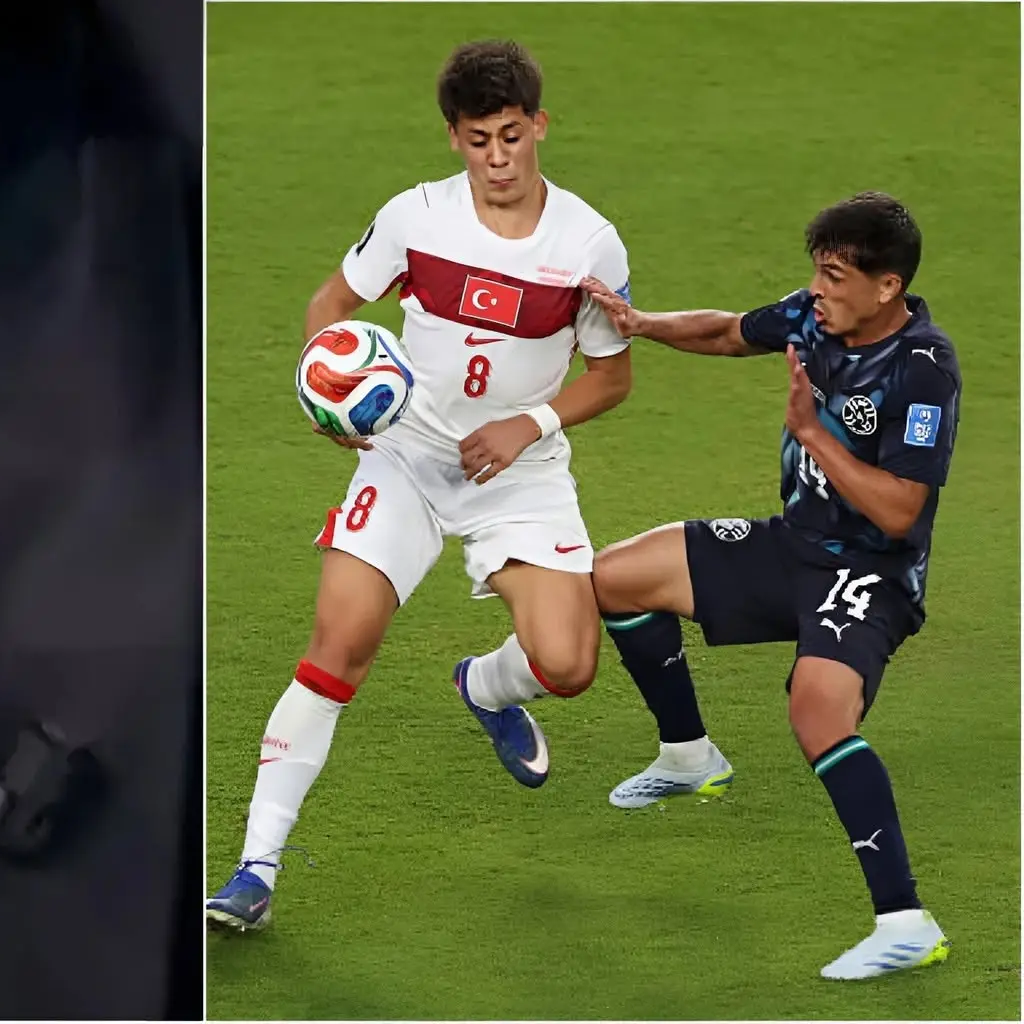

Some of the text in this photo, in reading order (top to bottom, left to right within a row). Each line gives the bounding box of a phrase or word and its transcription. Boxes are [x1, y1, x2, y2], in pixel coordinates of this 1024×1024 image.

[464, 354, 490, 398] 8
[346, 485, 377, 532] 8
[816, 568, 882, 621] 14
